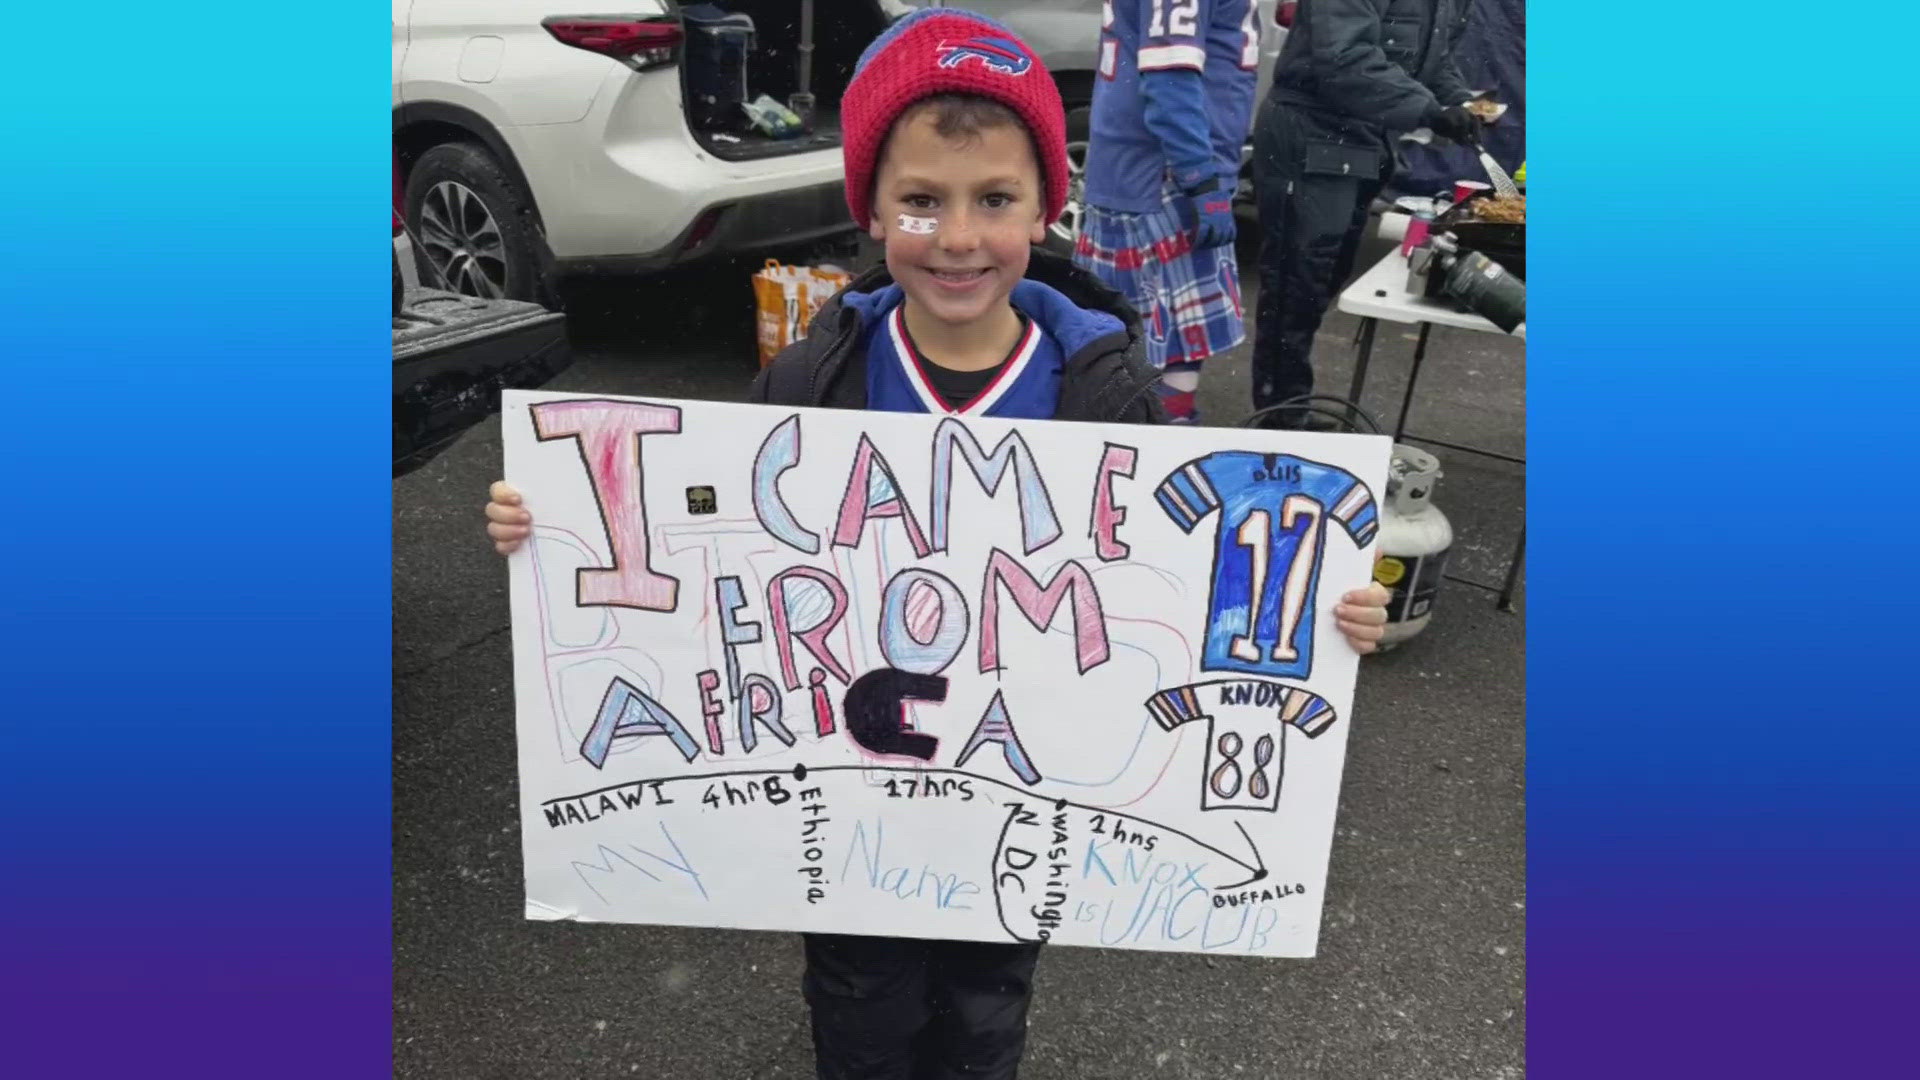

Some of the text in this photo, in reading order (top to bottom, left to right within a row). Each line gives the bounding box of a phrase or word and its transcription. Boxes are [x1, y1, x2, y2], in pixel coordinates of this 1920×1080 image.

[529, 399, 1139, 613] I CAME
[714, 546, 1111, 702] FROM
[1230, 493, 1325, 663] 17
[1220, 682, 1285, 708] KNOX
[543, 782, 675, 829] MALAWI
[884, 776, 975, 802] 17hrs
[1209, 731, 1275, 800] 88
[797, 786, 831, 905] Ethiopia
